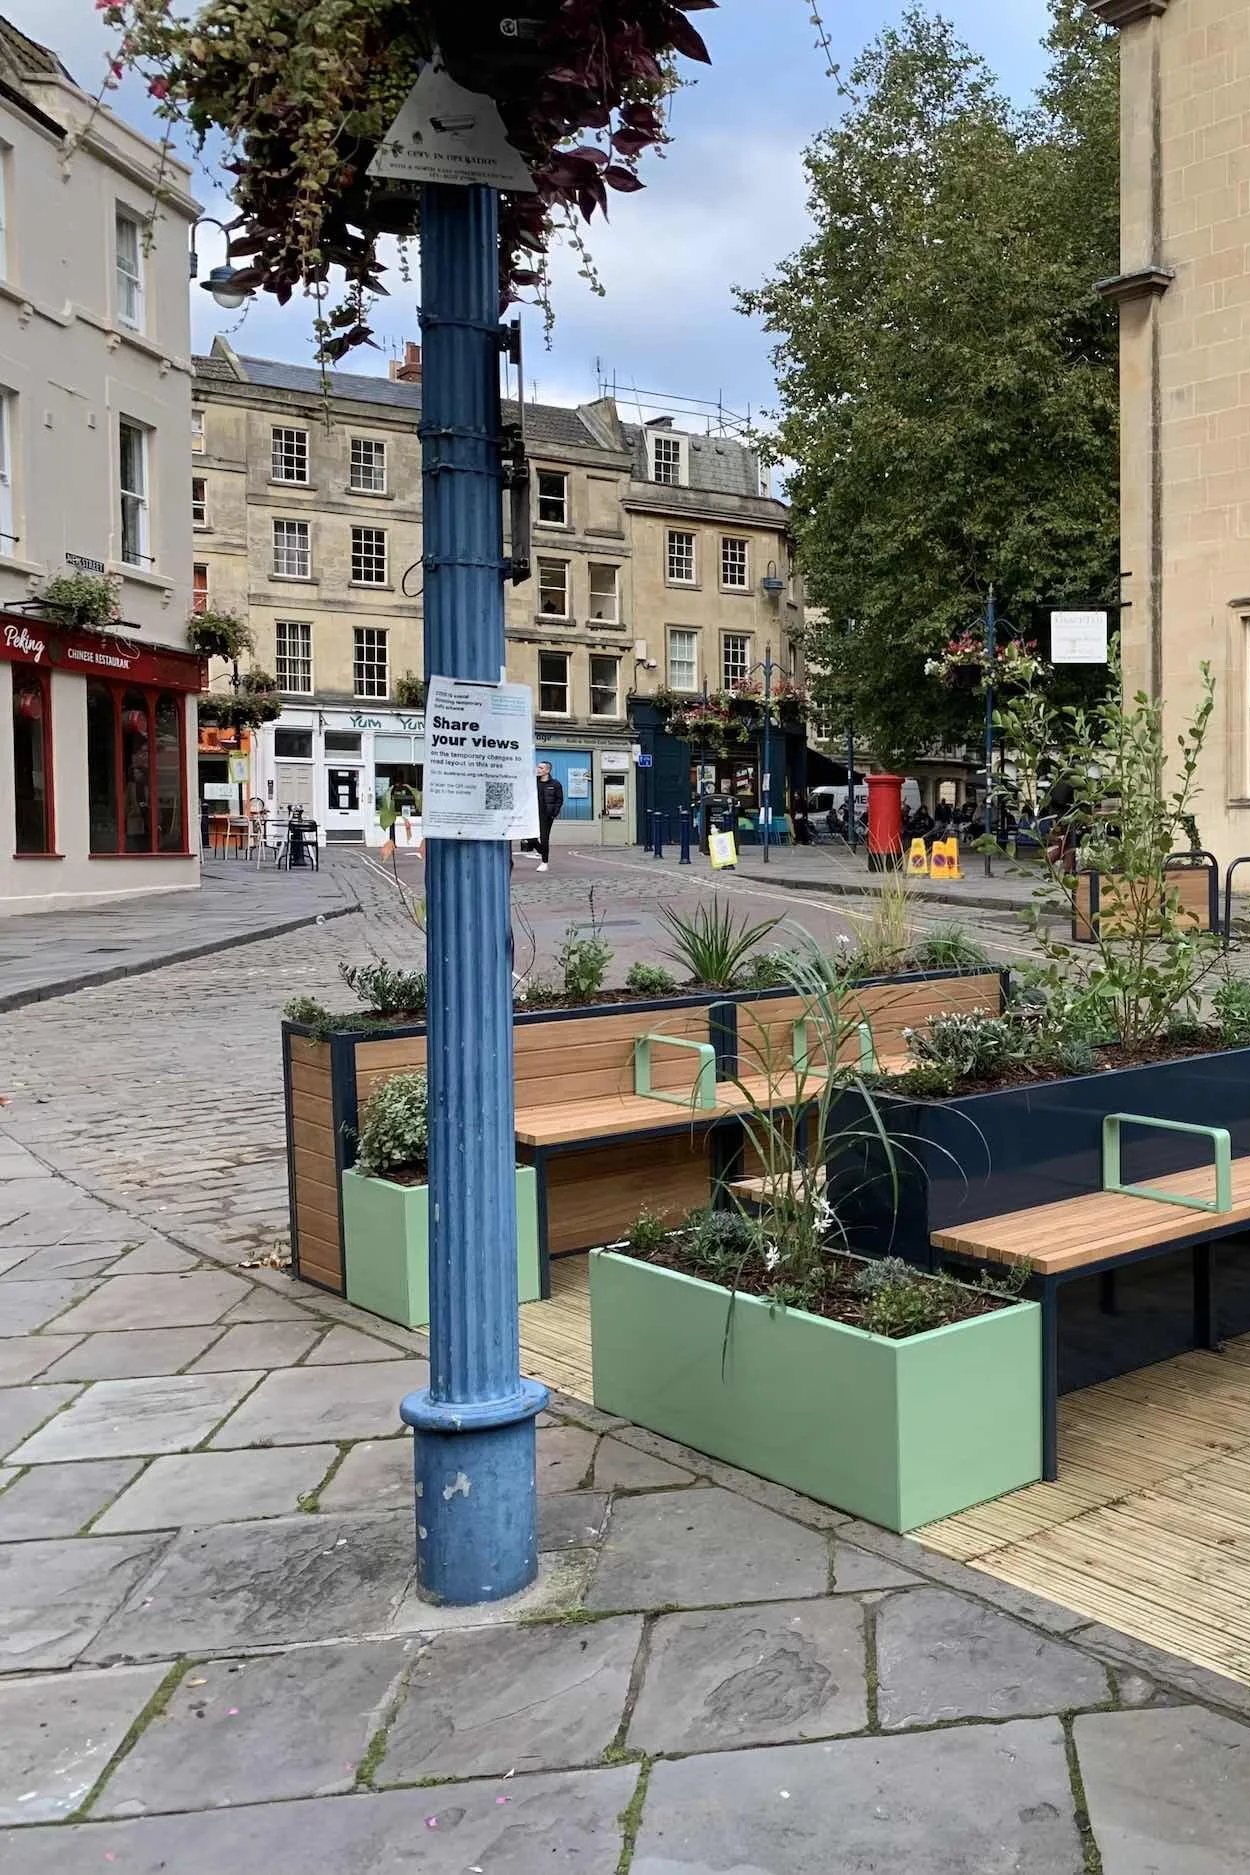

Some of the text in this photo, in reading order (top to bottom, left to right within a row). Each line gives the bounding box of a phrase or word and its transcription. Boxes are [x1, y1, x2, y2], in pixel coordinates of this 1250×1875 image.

[4, 625, 45, 663] Peking
[67, 648, 130, 669] CHINESE RESTAURAN
[433, 715, 480, 732] Share
[431, 733, 519, 750] your views
